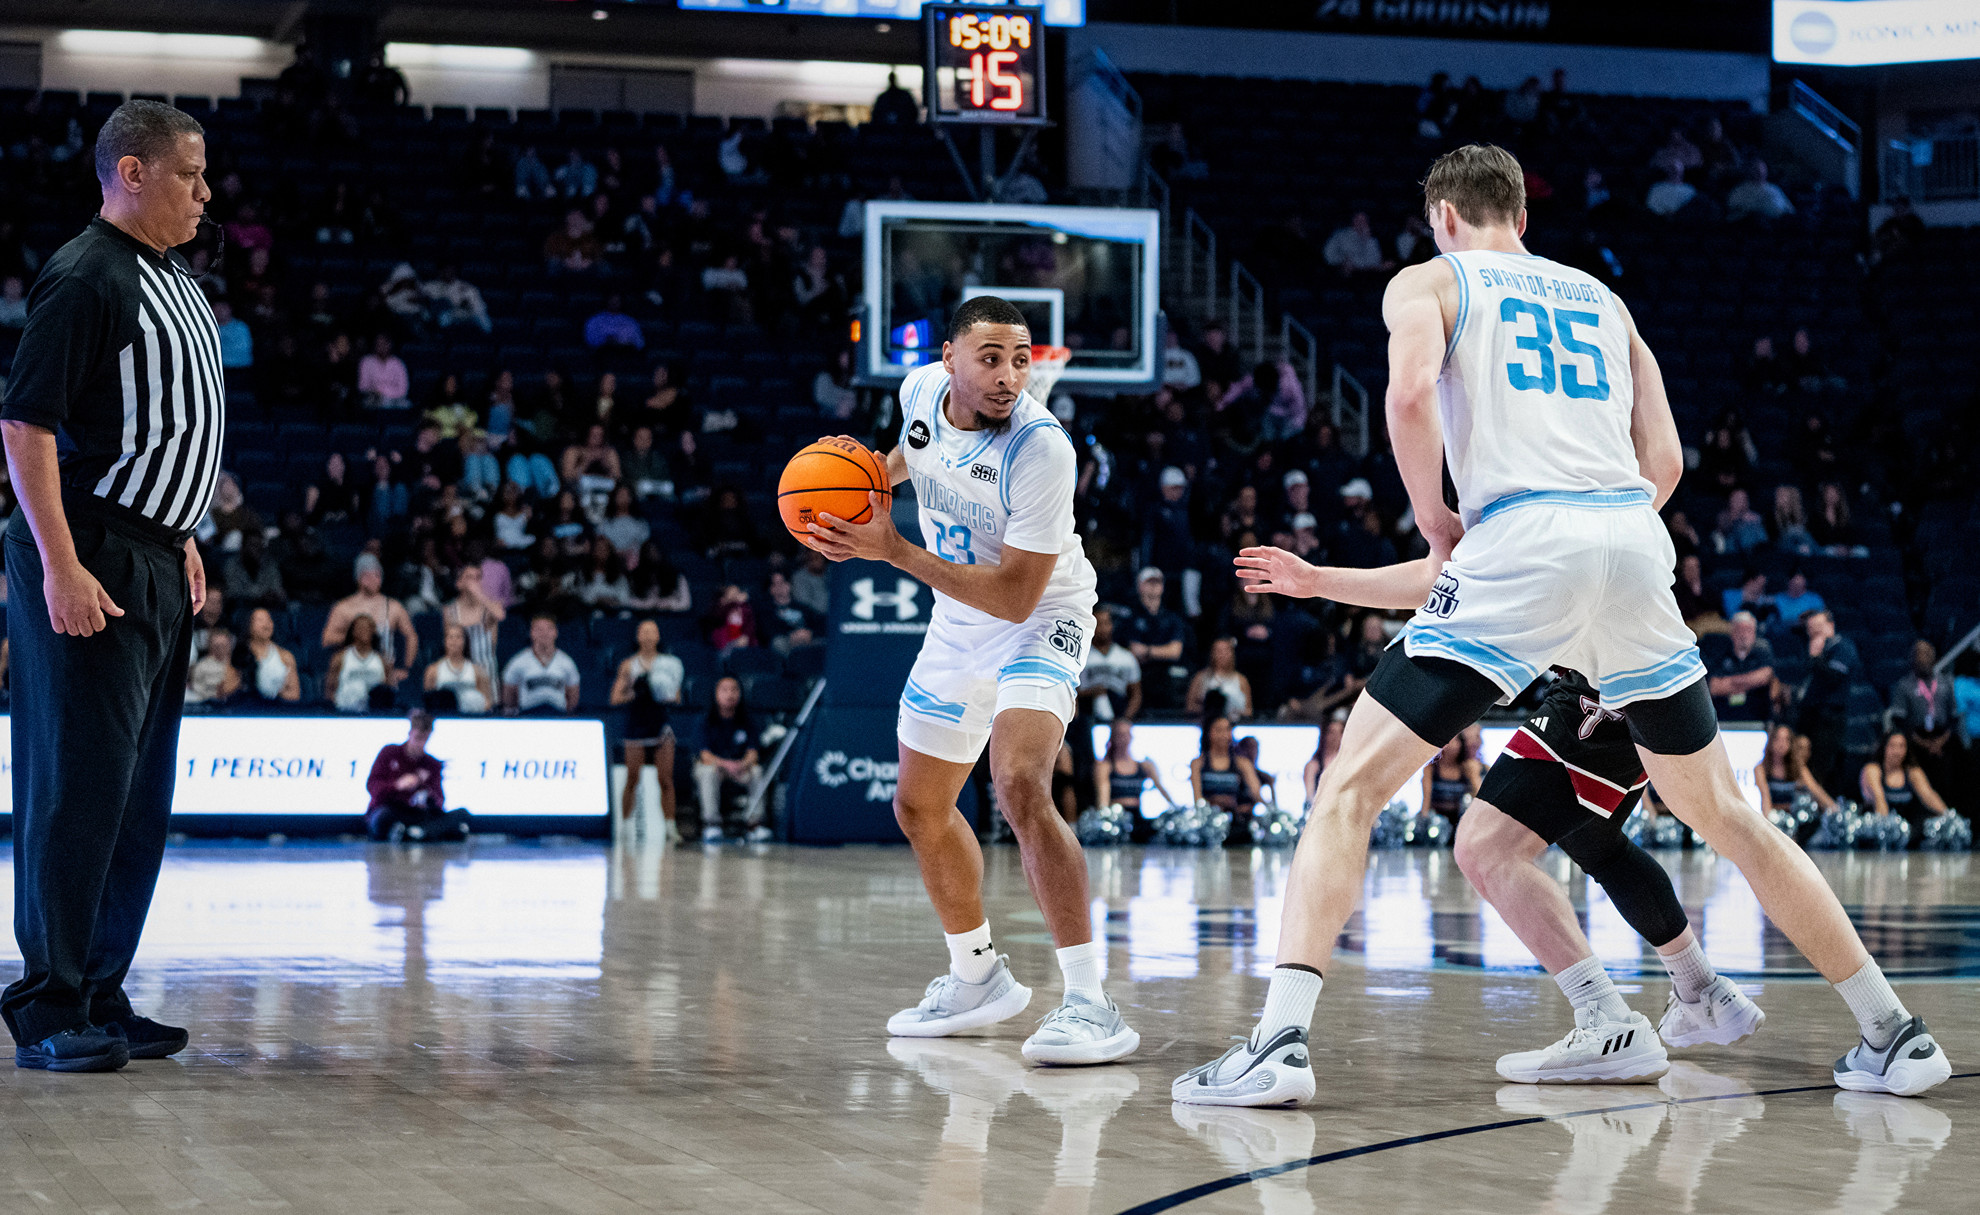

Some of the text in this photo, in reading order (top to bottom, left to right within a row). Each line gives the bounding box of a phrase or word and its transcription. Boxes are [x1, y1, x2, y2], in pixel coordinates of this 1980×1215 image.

[950, 14, 1031, 50] 15:09
[970, 50, 1023, 110] 15
[1500, 297, 1610, 401] 35
[971, 463, 998, 484] SBC
[930, 517, 976, 565] 23
[187, 758, 196, 778] 1
[349, 759, 358, 778] 1
[479, 760, 488, 779] 1
